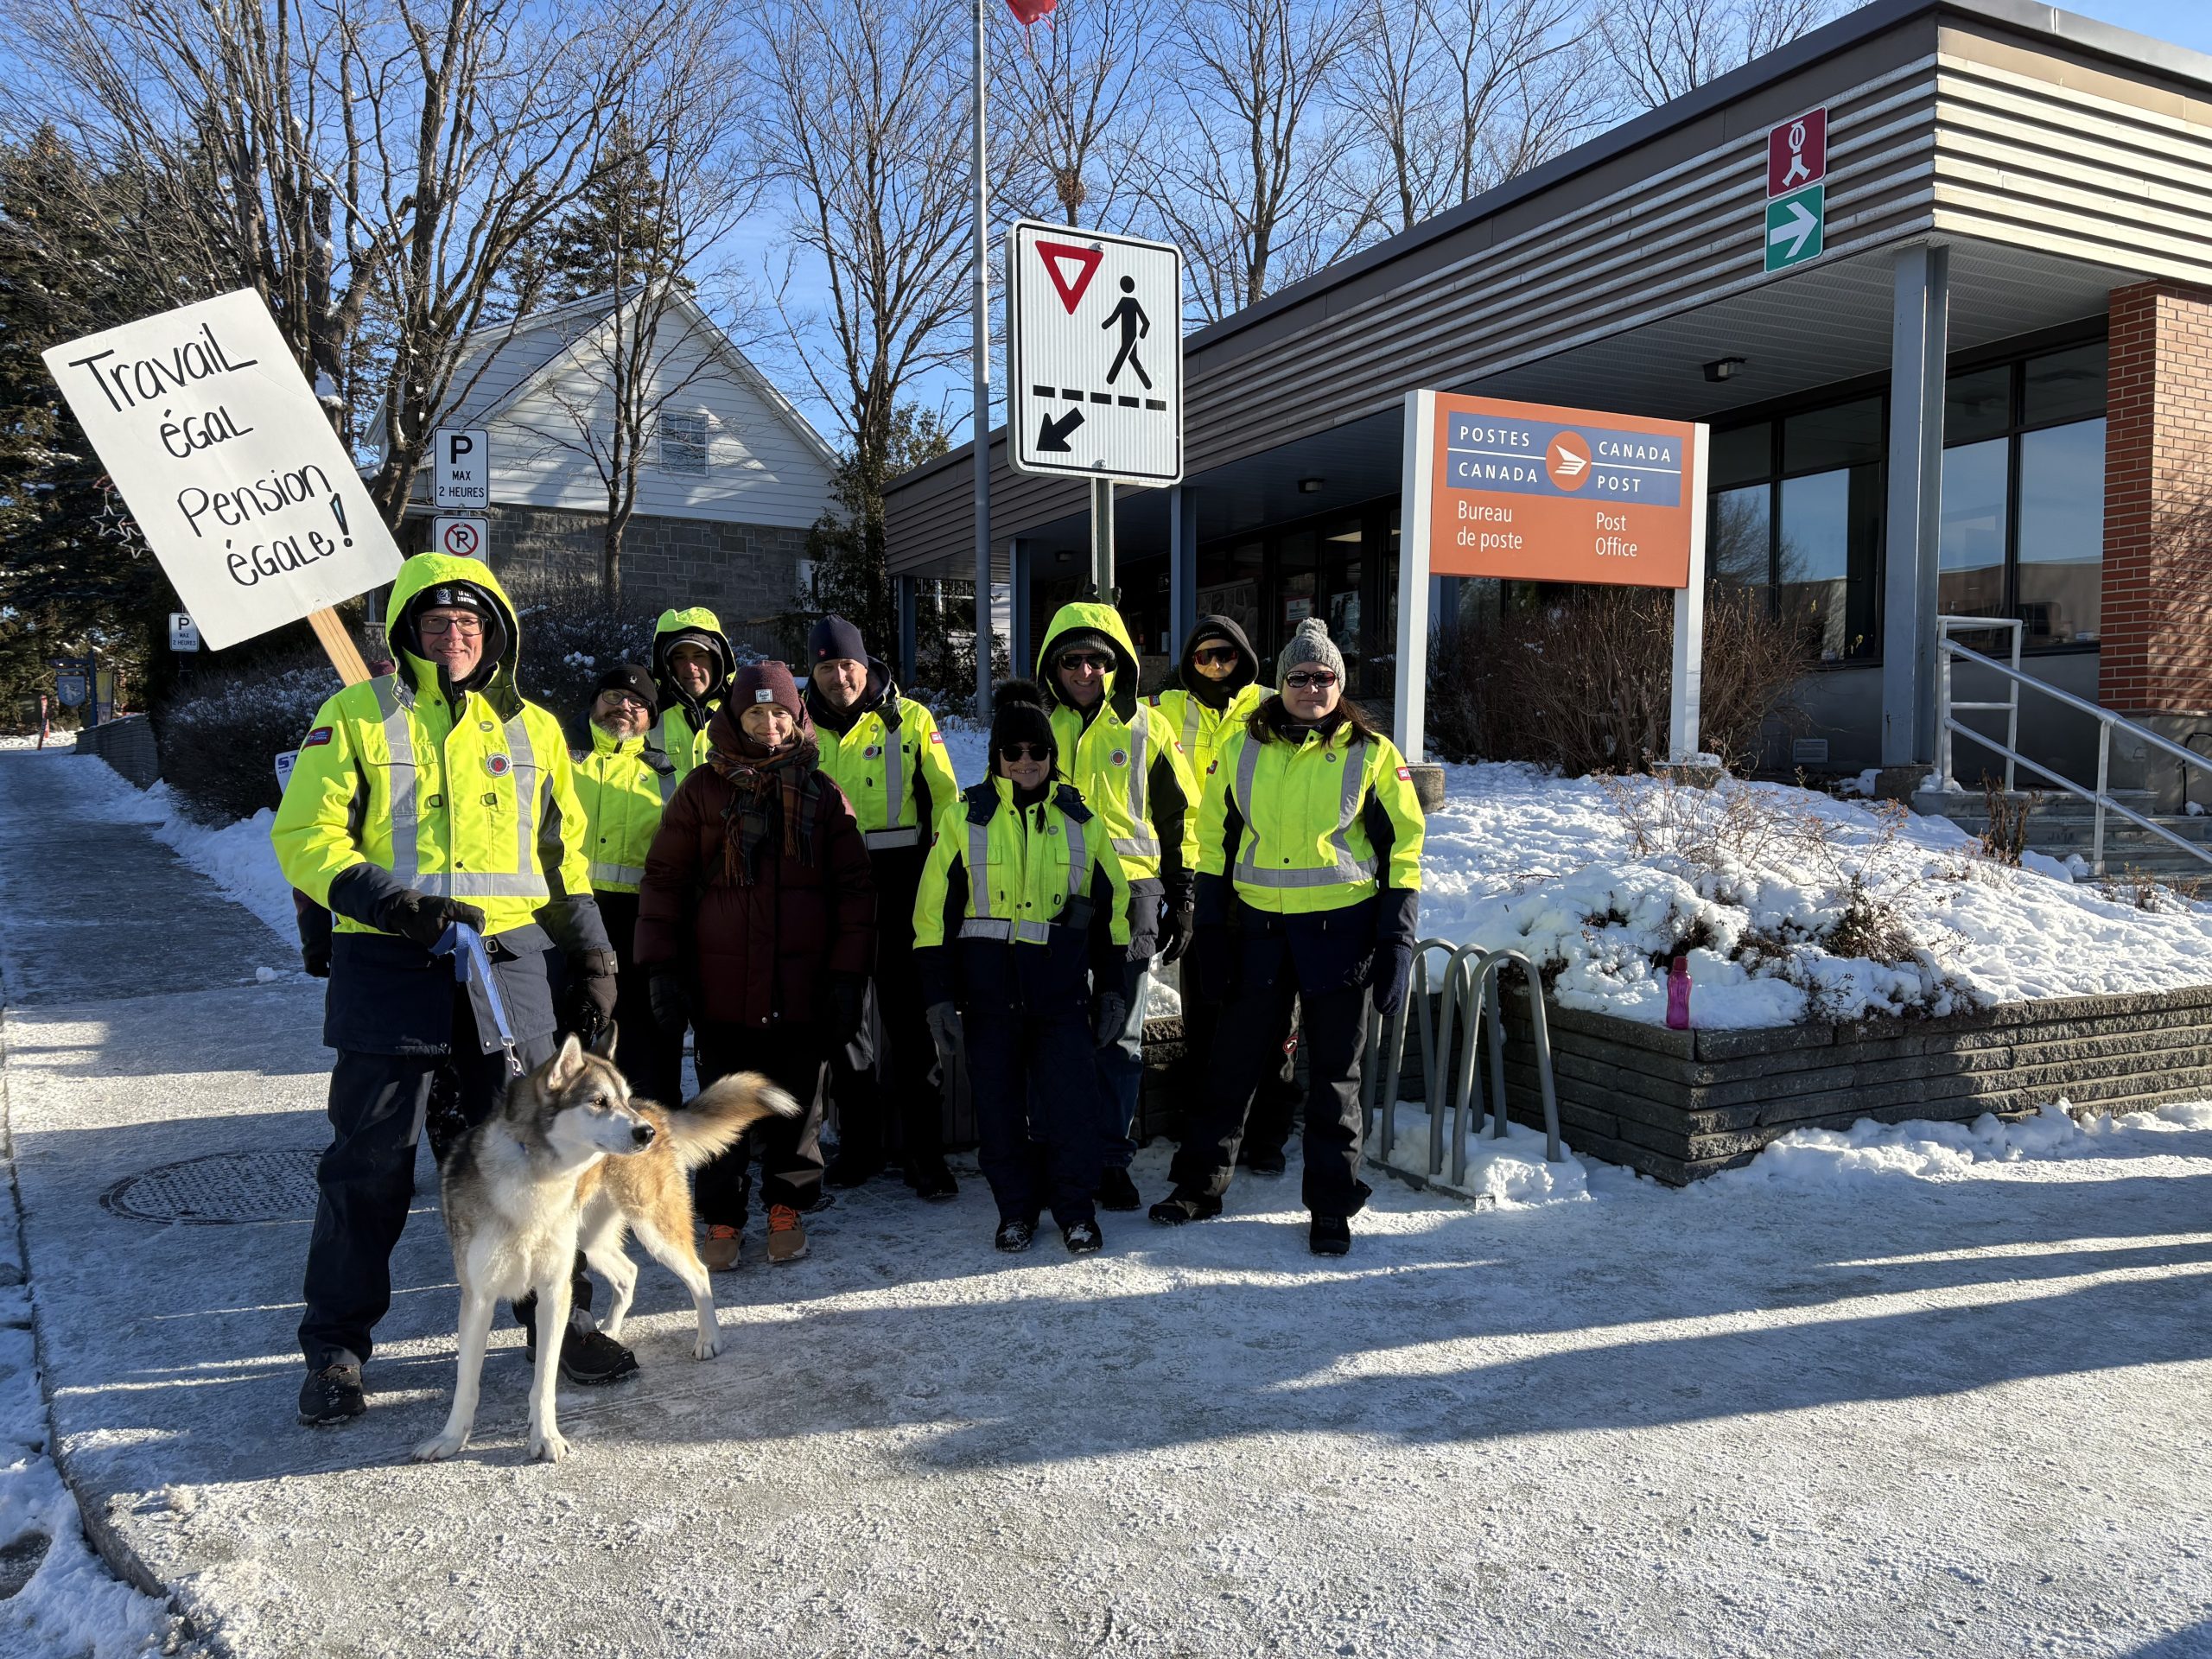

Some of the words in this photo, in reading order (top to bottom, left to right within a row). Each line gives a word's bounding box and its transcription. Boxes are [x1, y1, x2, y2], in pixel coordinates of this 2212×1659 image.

[1459, 426, 1530, 448] POSTES
[450, 435, 474, 465] P
[1599, 441, 1671, 463] CANADA
[452, 470, 471, 481] MAX
[1459, 461, 1538, 483] CANADA
[438, 486, 445, 497] 2
[448, 486, 485, 498] HEURES
[1598, 475, 1642, 493] POST
[177, 464, 333, 537] Pension
[1458, 500, 1512, 523] Bureau
[1596, 512, 1627, 532] Post
[1457, 526, 1476, 547] de
[1480, 531, 1522, 552] poste
[1595, 537, 1638, 557] Office
[178, 617, 190, 631] P
